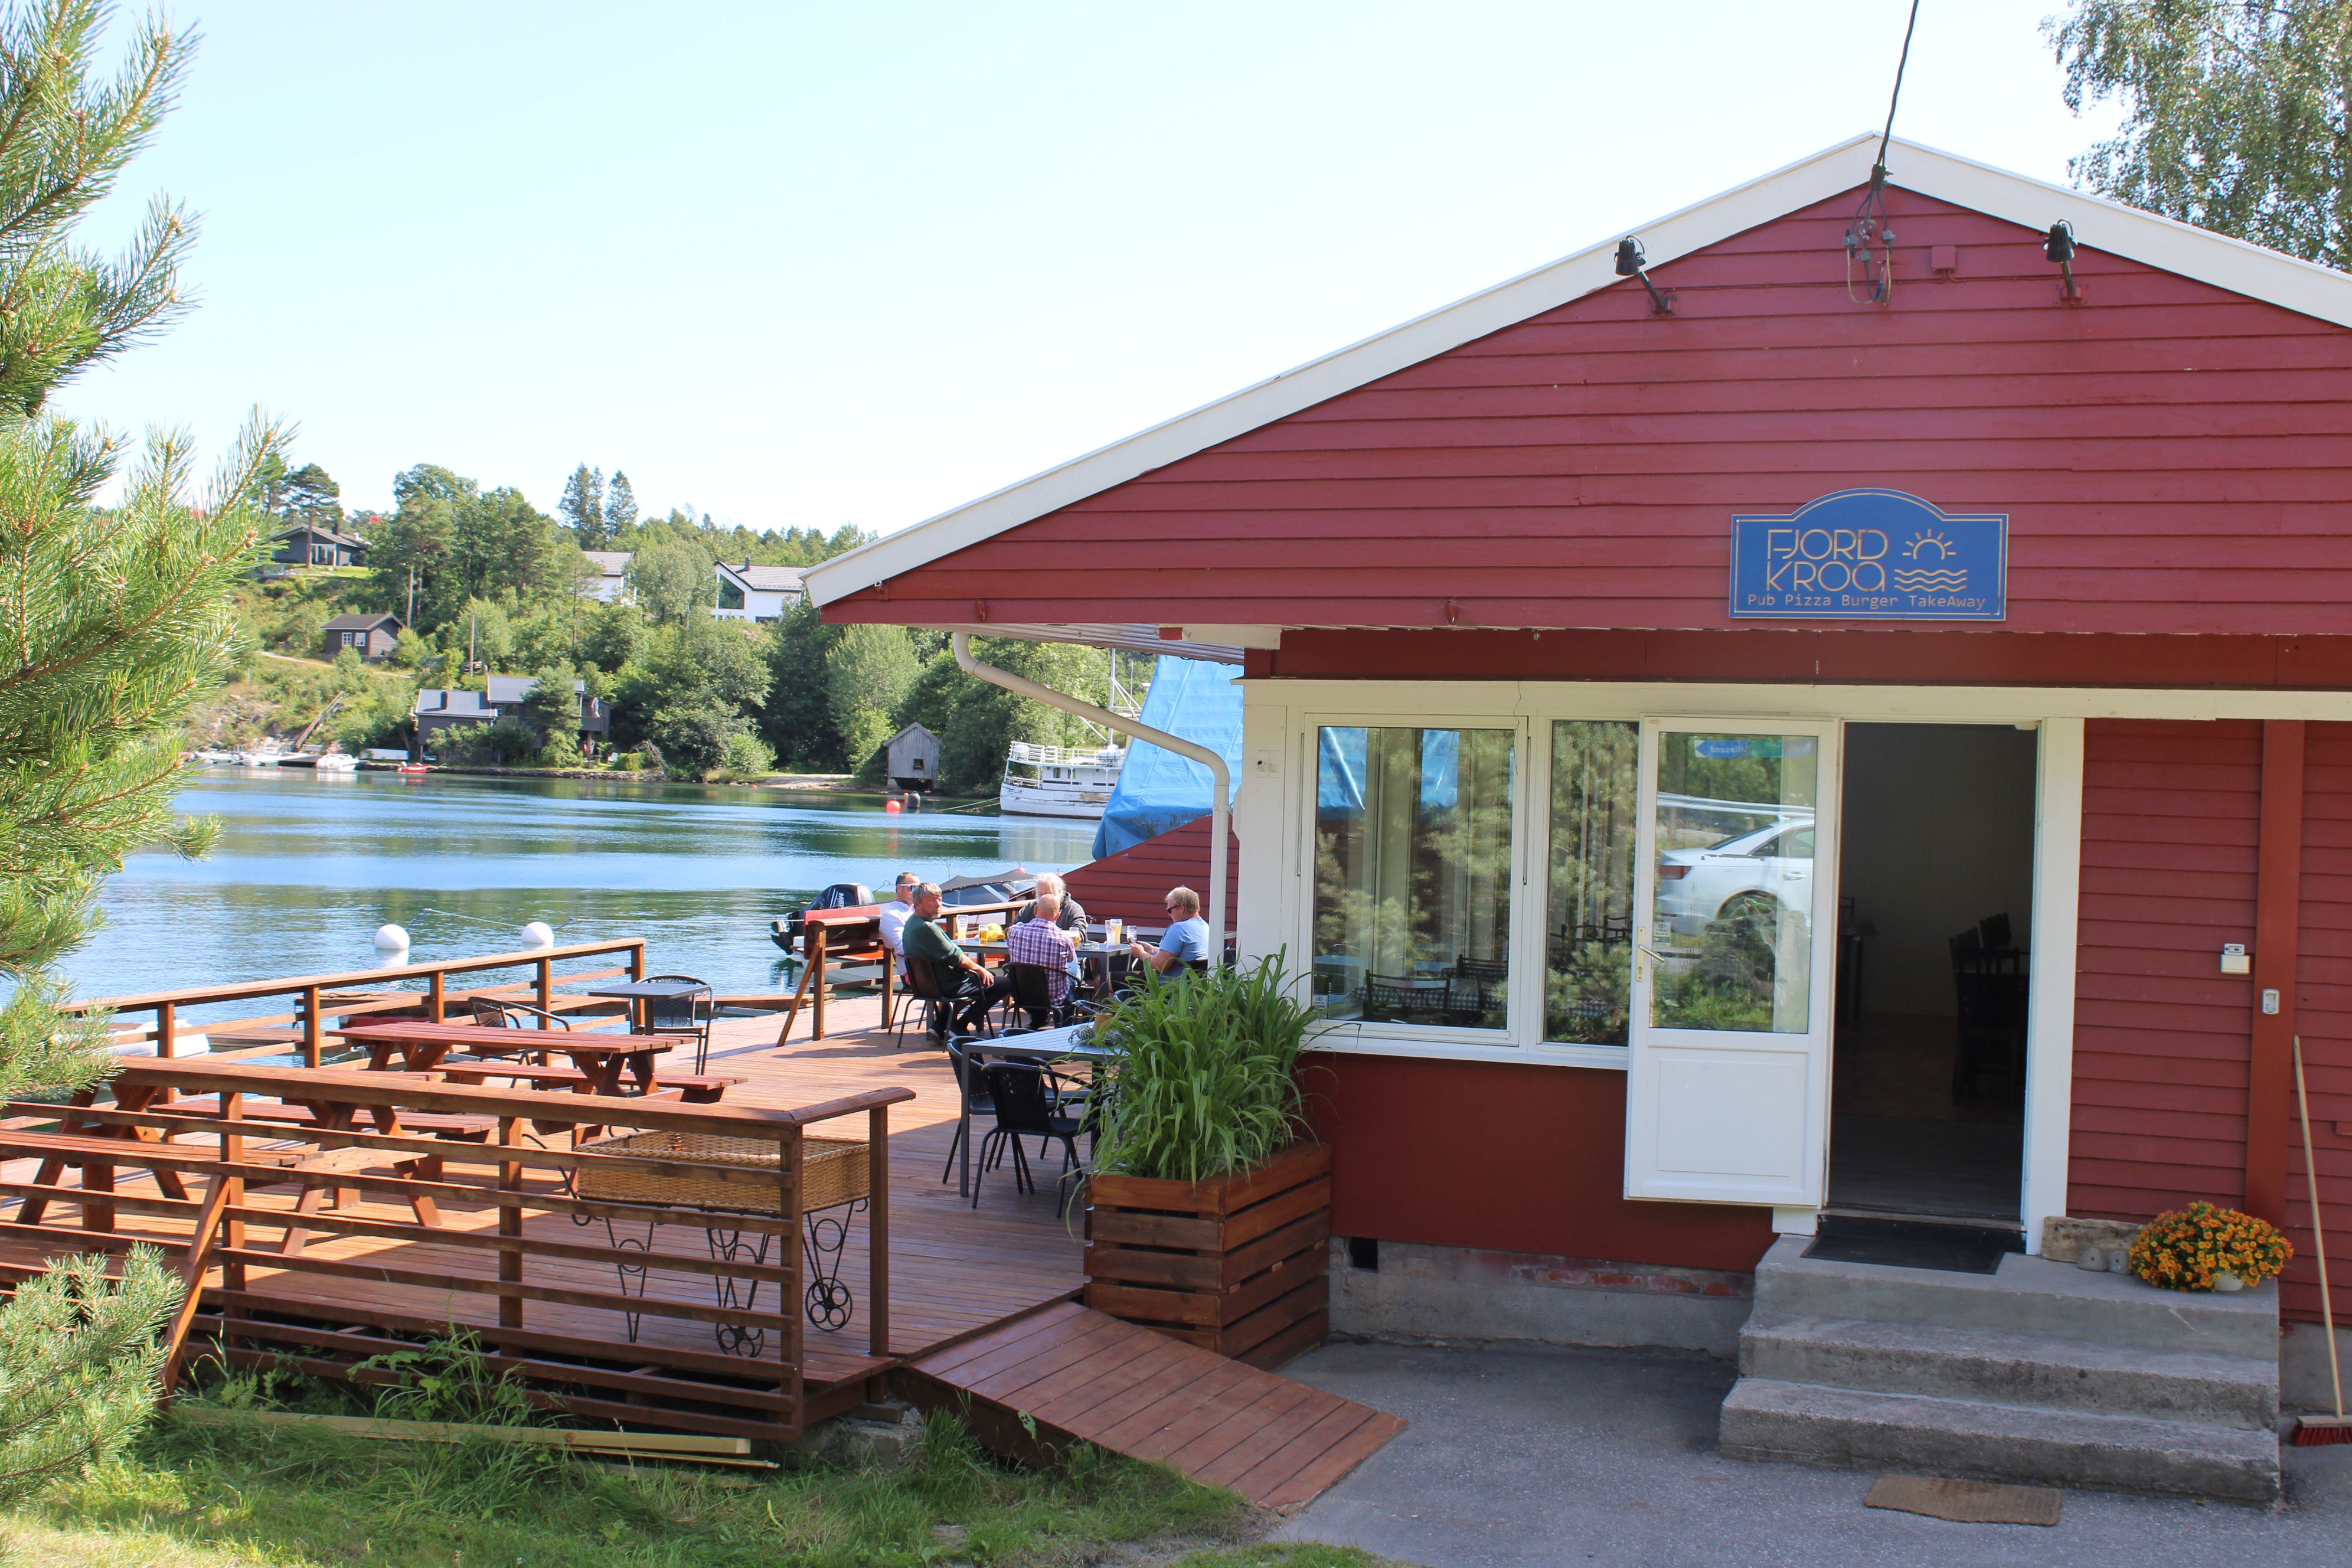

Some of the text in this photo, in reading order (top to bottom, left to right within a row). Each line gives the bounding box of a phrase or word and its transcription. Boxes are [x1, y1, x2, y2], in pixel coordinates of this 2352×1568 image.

[1767, 529, 1888, 560] FJORD
[1748, 594, 1985, 610] Pub Pizza Burger TakeAway
